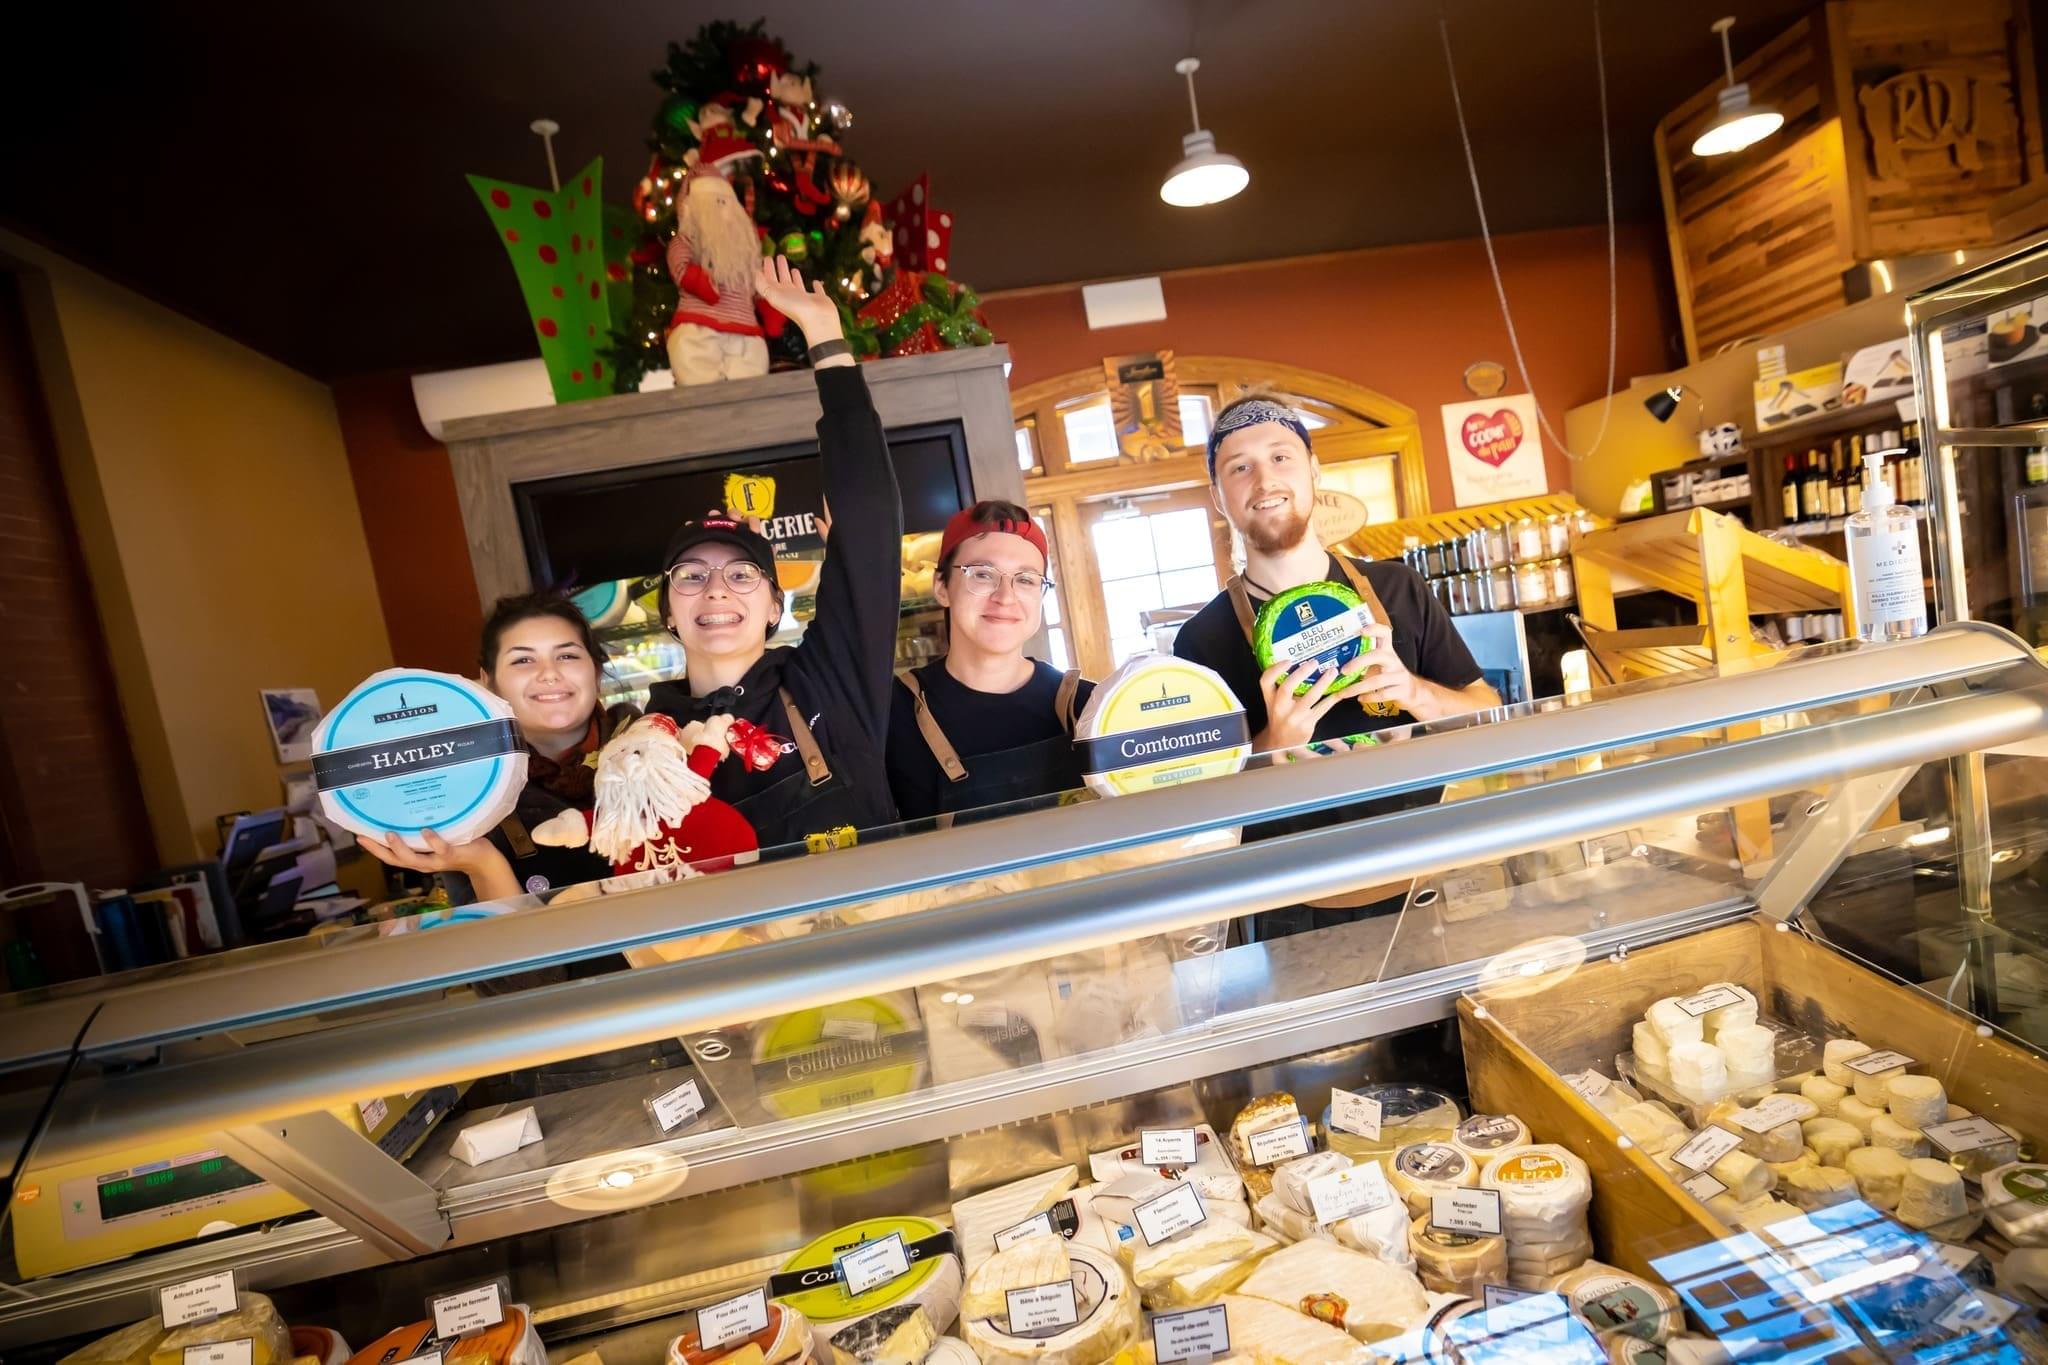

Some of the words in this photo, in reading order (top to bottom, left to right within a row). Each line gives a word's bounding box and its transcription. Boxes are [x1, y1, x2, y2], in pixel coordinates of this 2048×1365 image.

[1301, 625, 1325, 641] BLEU
[1150, 696, 1189, 708] STATION
[386, 706, 435, 721] STATION
[1121, 728, 1222, 758] Comtomme
[371, 741, 456, 770] HATLEY
[1502, 1171, 1519, 1181] LE
[1522, 1168, 1557, 1180] PIZY
[1452, 1201, 1478, 1209] Munster
[1468, 1220, 1482, 1228] 100g
[173, 1288, 194, 1300] Alfred
[195, 1287, 203, 1295] 24
[443, 1303, 461, 1313] Alfred
[469, 1295, 490, 1306] fermier
[716, 1311, 729, 1319] Fou
